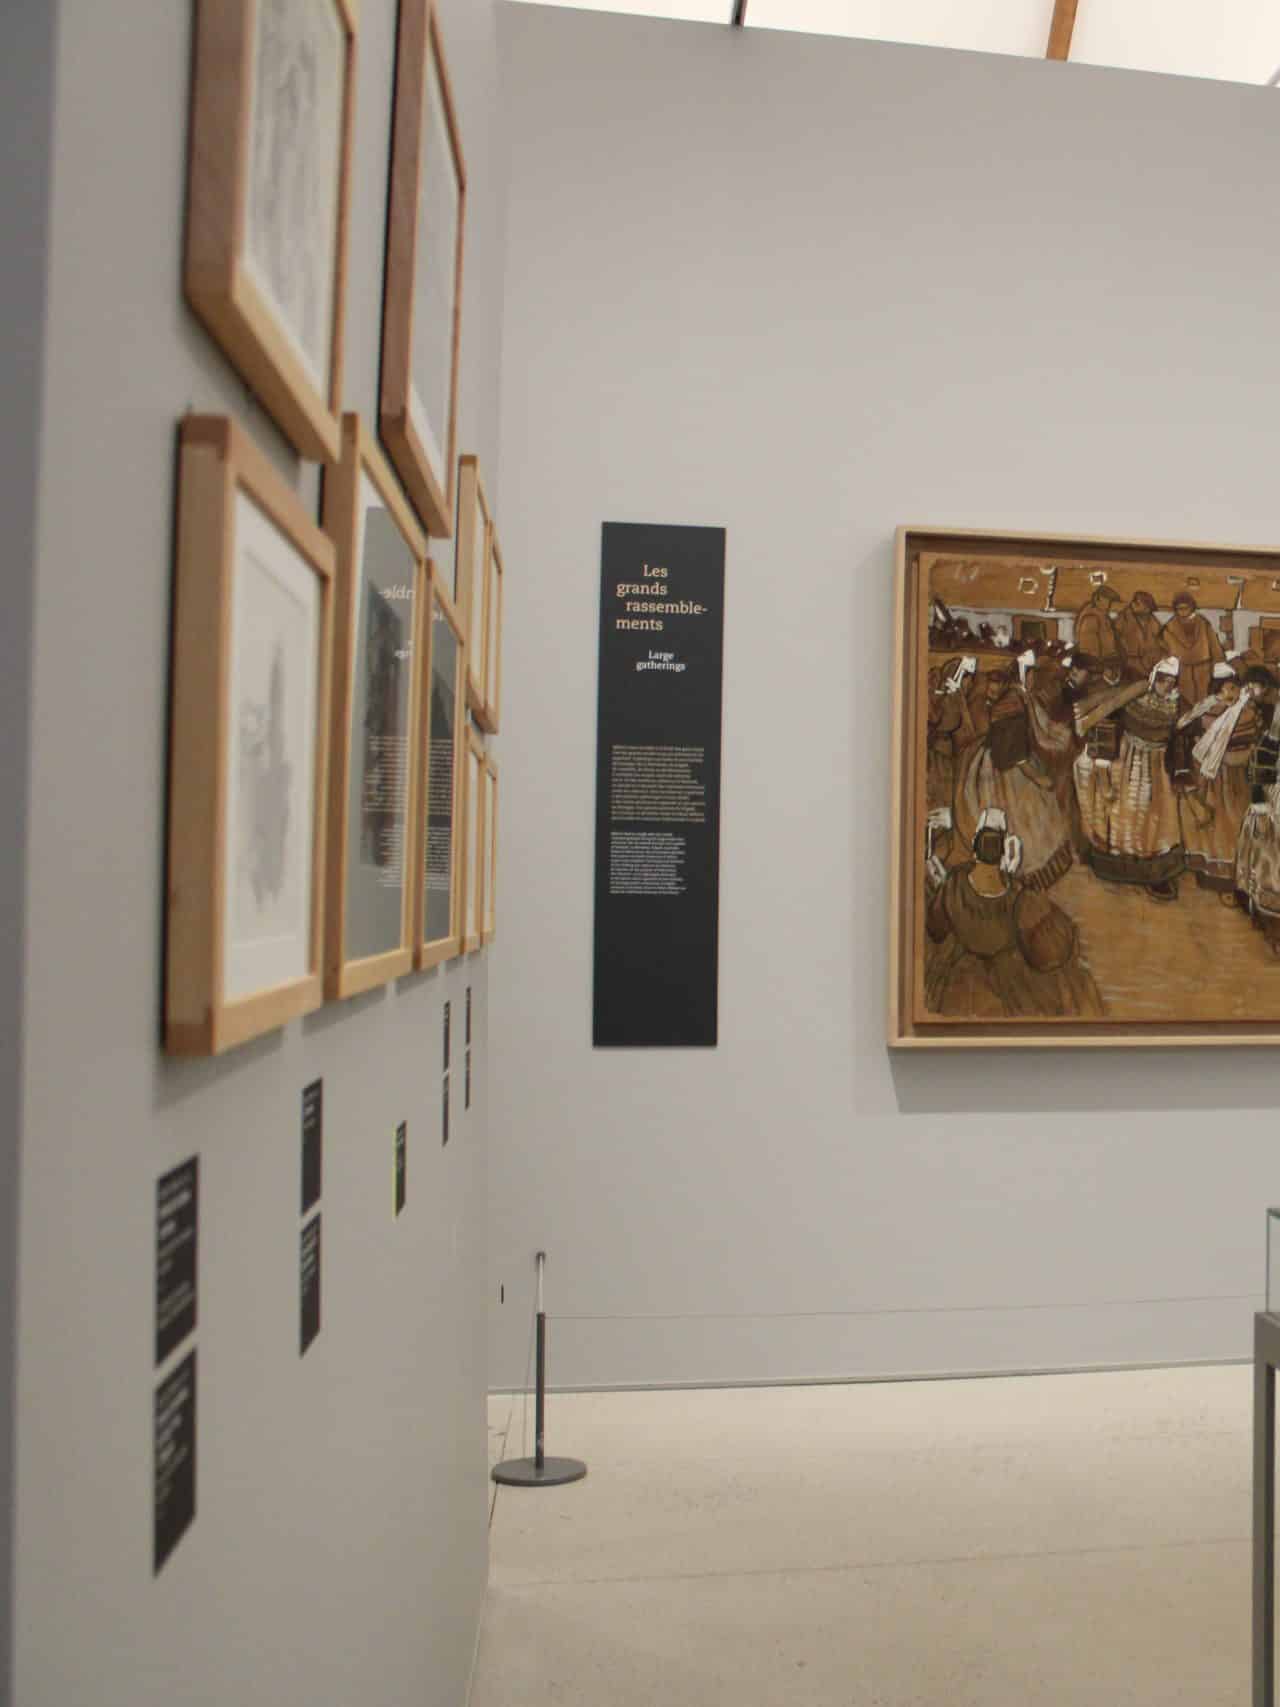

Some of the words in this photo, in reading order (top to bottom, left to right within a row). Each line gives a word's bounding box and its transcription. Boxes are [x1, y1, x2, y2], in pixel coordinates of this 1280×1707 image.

[643, 564, 668, 578] Les
[616, 582, 668, 597] grands
[626, 601, 708, 614] rassemble-
[616, 619, 663, 631] ments
[648, 649, 674, 662] Large
[636, 660, 686, 672] gatherings
